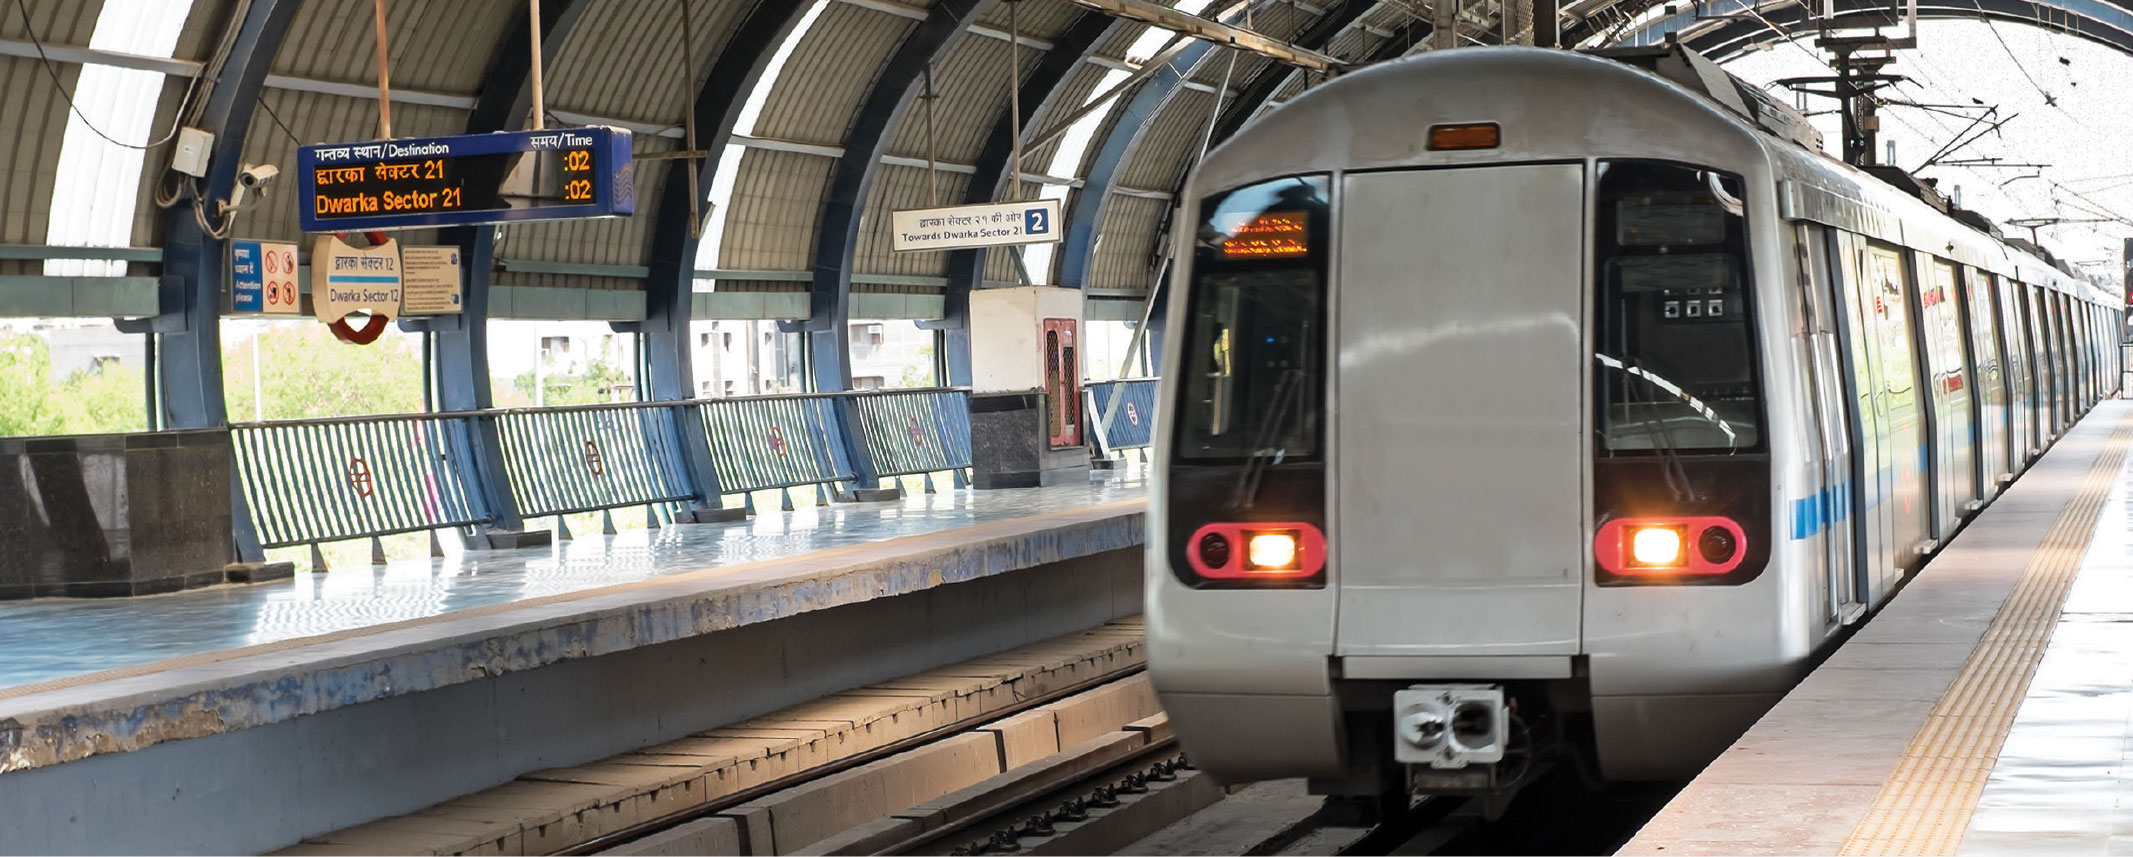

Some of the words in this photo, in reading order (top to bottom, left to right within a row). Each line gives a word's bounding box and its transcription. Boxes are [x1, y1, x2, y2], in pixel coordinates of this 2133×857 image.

[530, 132, 593, 149] समय/Time
[353, 142, 449, 160] स्थान/Destination
[564, 150, 590, 171] :02
[316, 167, 365, 185] द्वारका
[374, 162, 420, 181] सेक्टर
[424, 159, 444, 179] 21
[564, 179, 591, 200] :02
[316, 192, 378, 214] Dwarka
[383, 189, 437, 211] Sector
[442, 187, 461, 207] 21
[1031, 212, 1044, 231] 2
[902, 230, 941, 242] Towards
[944, 227, 979, 239] Dwarka
[980, 228, 1010, 238] Sector
[1013, 226, 1022, 236] 21
[335, 256, 358, 270] द्वारका
[360, 252, 384, 270] सेक्टर
[385, 257, 394, 271] 12
[330, 289, 361, 302] Dwarka
[363, 288, 389, 302] Sector
[390, 289, 399, 302] 12
